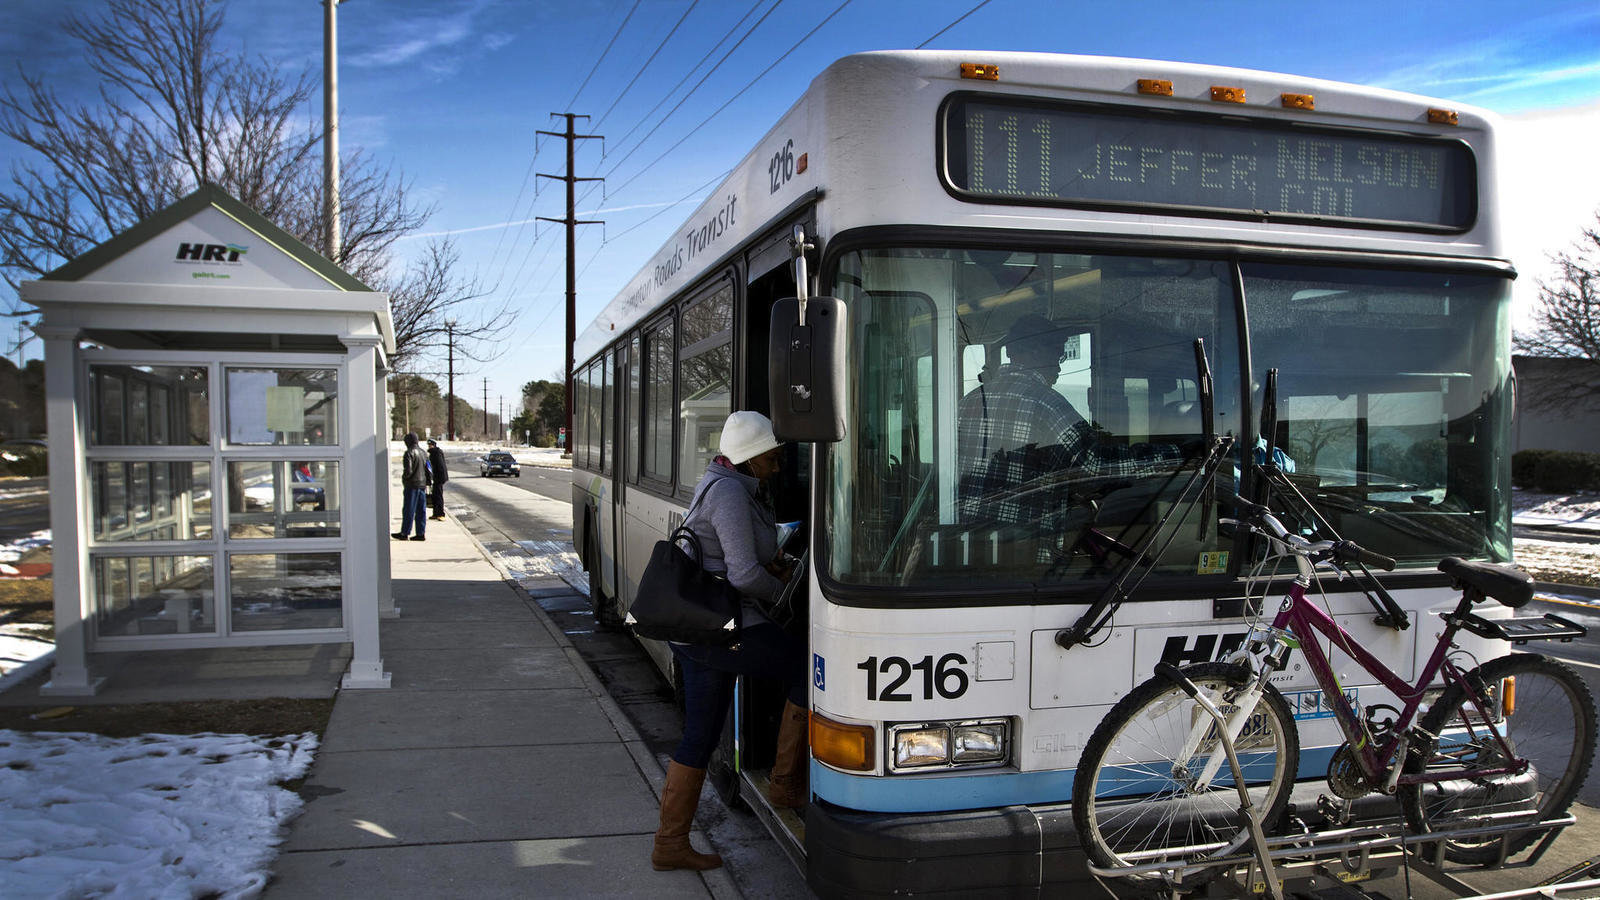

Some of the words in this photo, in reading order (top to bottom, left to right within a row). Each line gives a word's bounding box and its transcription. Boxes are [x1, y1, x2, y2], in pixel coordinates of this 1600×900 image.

[768, 139, 794, 195] 1216
[965, 113, 1058, 197] 111
[1077, 143, 1257, 192] JEFFER
[1277, 139, 1437, 189] NELSON
[176, 242, 248, 262] HRT
[654, 244, 683, 292] Roads
[687, 193, 737, 262] Transit
[857, 653, 969, 702] 1216
